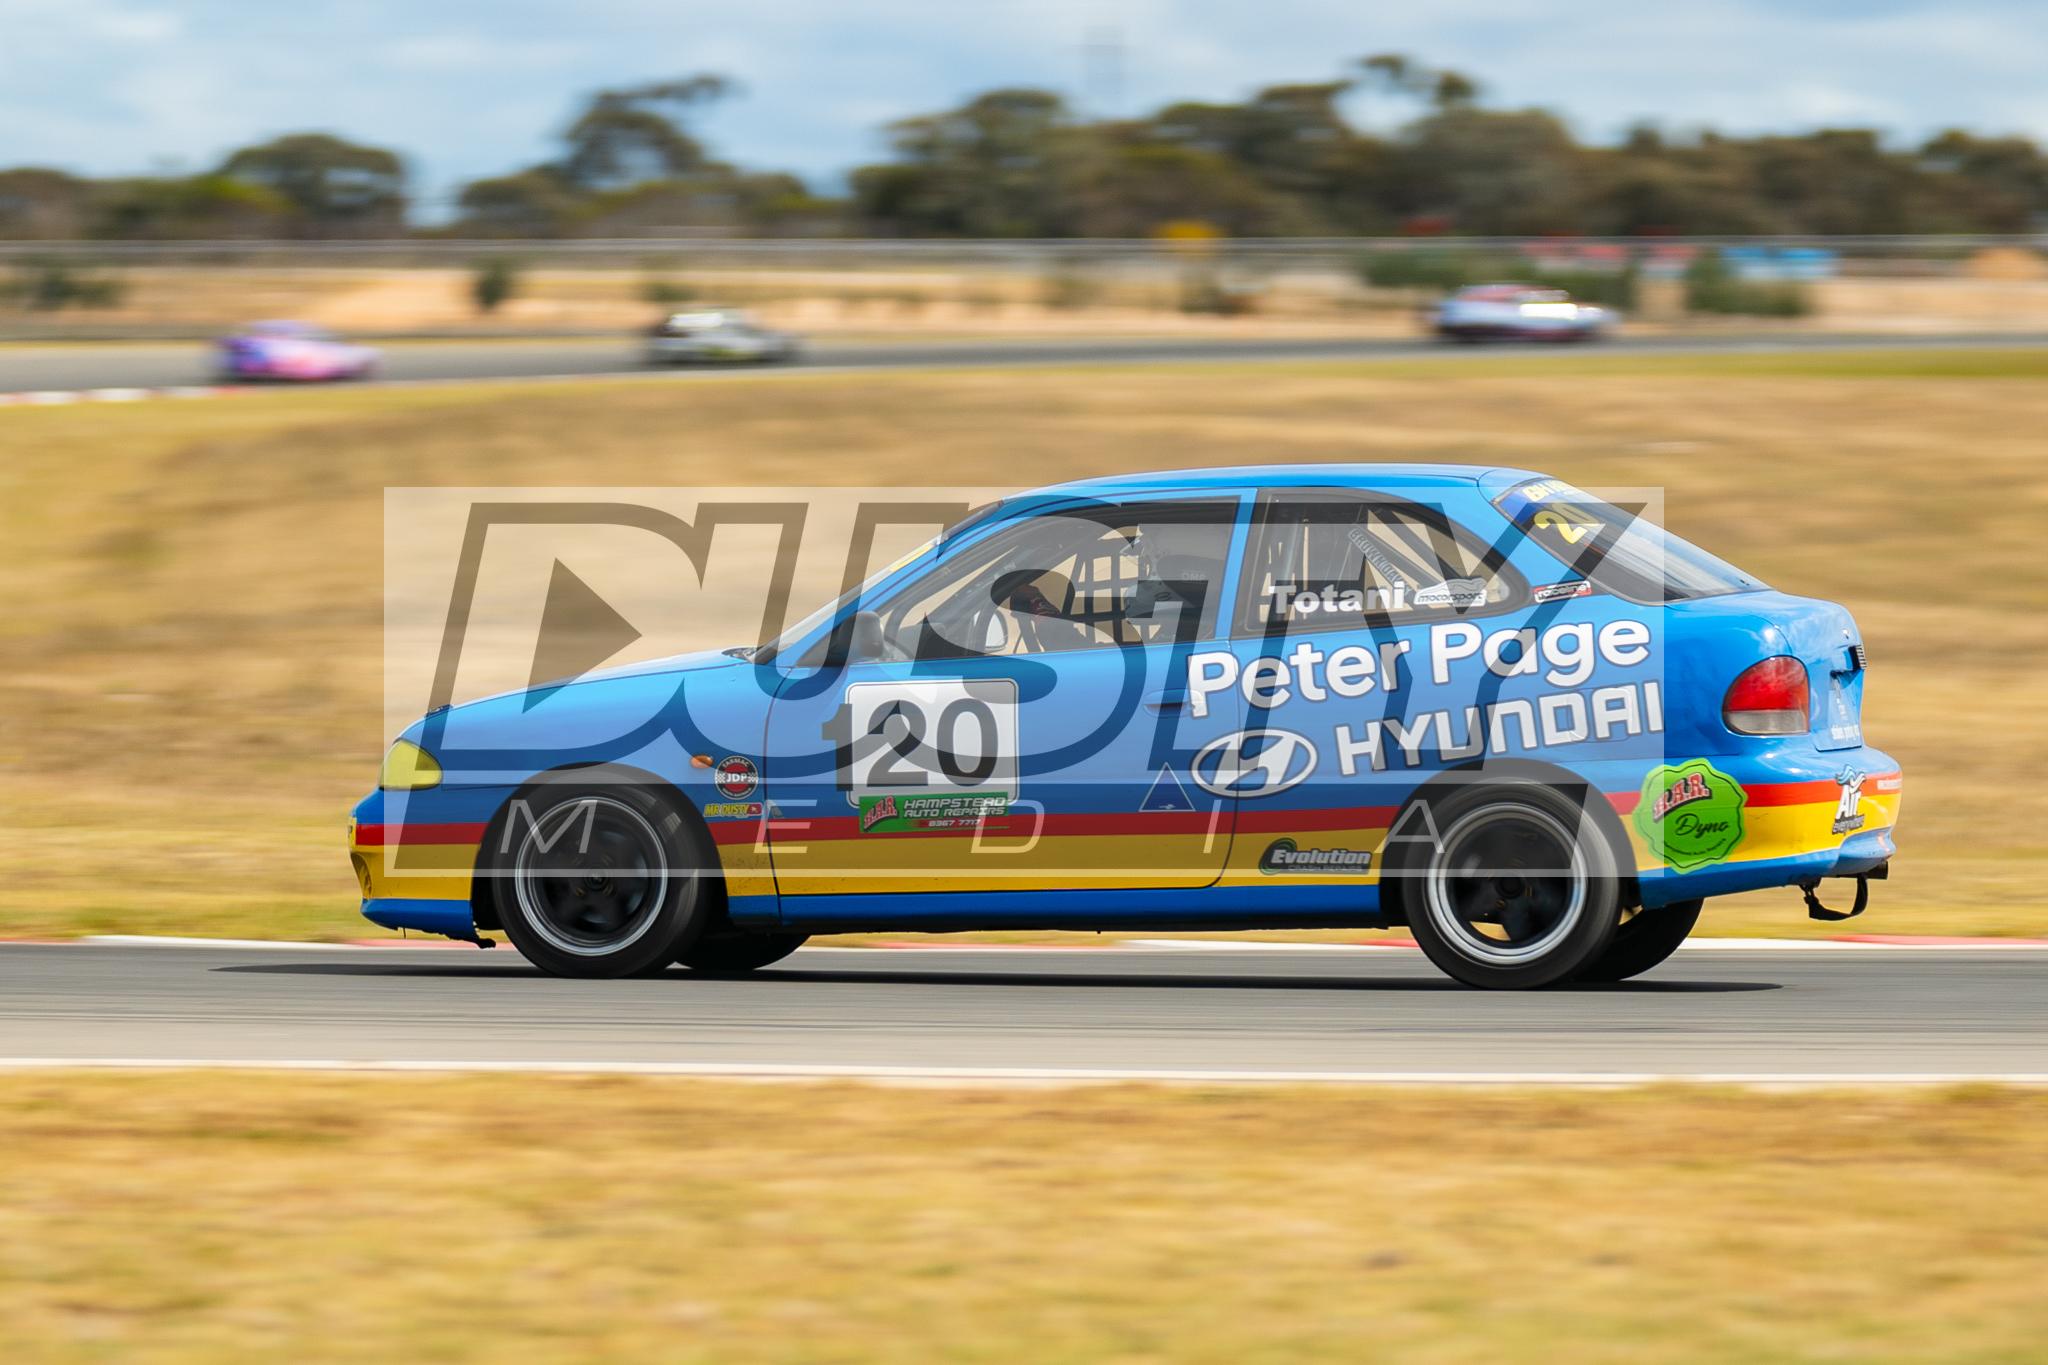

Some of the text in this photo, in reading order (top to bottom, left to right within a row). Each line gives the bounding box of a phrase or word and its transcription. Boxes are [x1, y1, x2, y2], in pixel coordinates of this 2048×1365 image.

[1269, 581, 1405, 613] Totani
[1187, 620, 1651, 718] Peter Page
[1335, 682, 1664, 775] HYUNDAI
[822, 698, 998, 791] 120
[726, 773, 748, 783] JDP
[904, 797, 1006, 809] HAMPSTEAD
[904, 807, 1005, 818] AUTO REPAIRS
[1675, 813, 1728, 839] Dyno
[1271, 849, 1371, 864] Evolution
